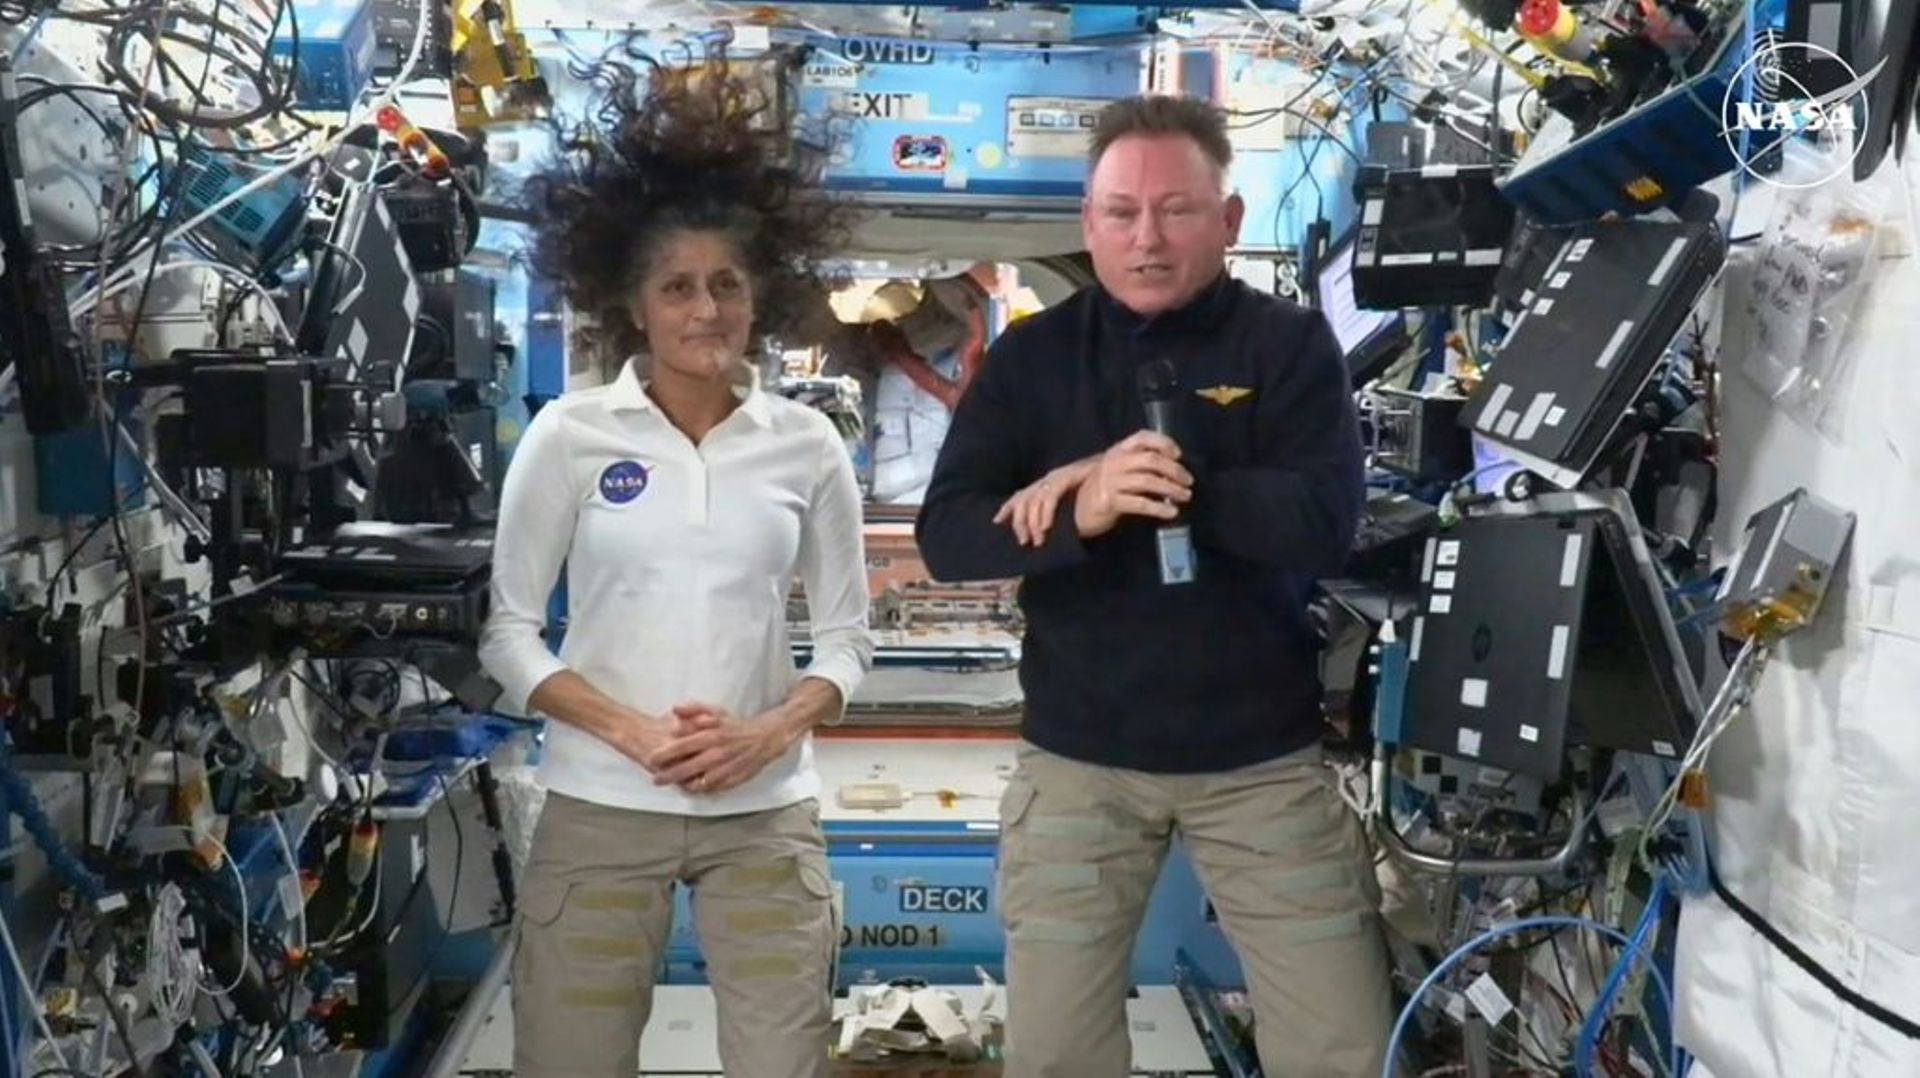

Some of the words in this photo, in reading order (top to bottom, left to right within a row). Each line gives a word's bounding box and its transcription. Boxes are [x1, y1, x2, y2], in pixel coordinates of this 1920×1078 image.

[843, 38, 932, 63] OVHD
[845, 92, 912, 118] EXIT
[603, 476, 643, 489] NASA
[903, 887, 983, 911] DECK
[861, 925, 919, 946] NOD
[928, 925, 938, 946] 1
